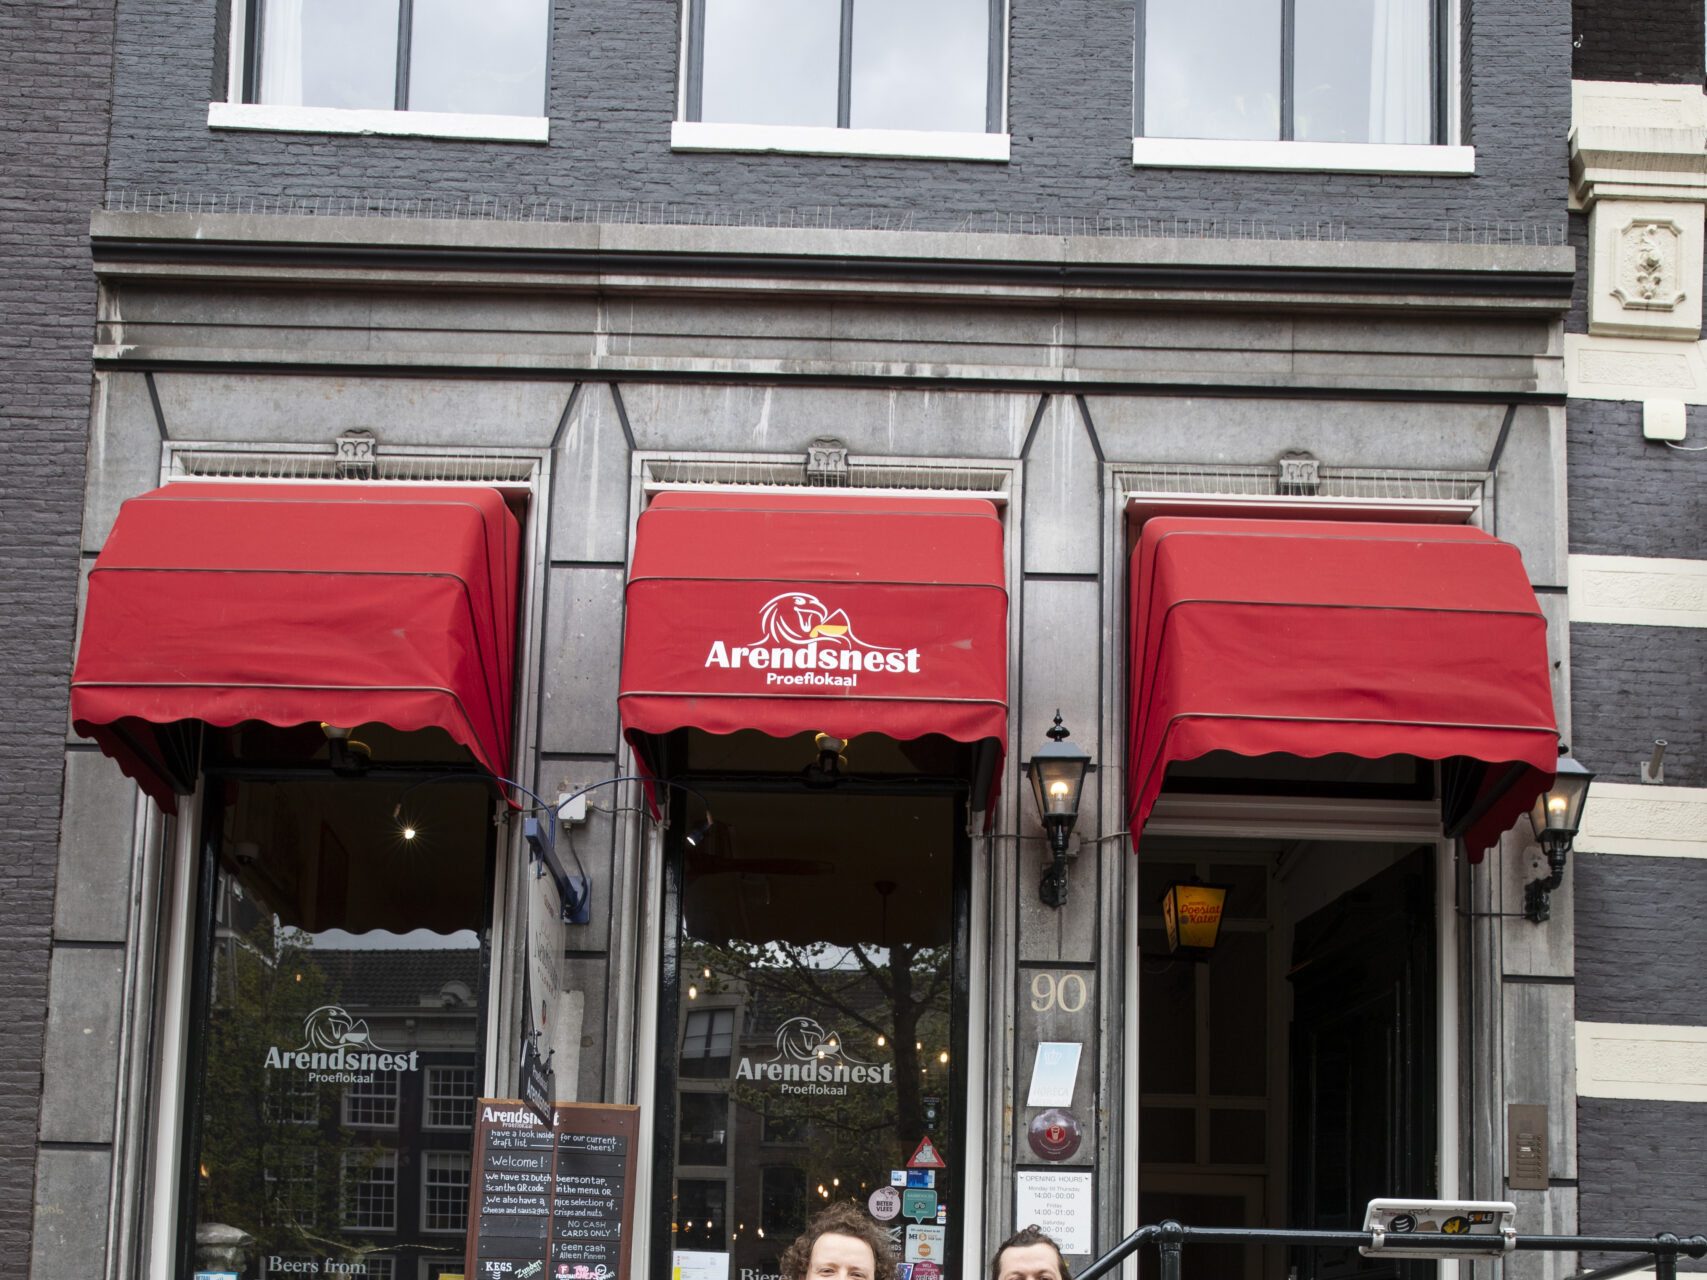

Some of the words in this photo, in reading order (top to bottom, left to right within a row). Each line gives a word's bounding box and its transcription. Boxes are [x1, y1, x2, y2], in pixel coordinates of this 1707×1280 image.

[704, 641, 920, 673] Arendsnest
[766, 672, 857, 687] Proeflokaal
[1031, 973, 1087, 1012] 90
[264, 1046, 419, 1072] Arendsnest
[735, 1057, 892, 1084] Arendsnest
[308, 1072, 374, 1084] Proeflokaal
[781, 1084, 847, 1096] Proeflokaal
[481, 1106, 560, 1127] Arendsnt
[491, 1129, 511, 1137] have
[519, 1130, 535, 1138] look
[492, 1138, 512, 1149] draft
[514, 1139, 528, 1148] list
[500, 1172, 520, 1181] have
[530, 1173, 552, 1182] Dutch
[528, 1183, 545, 1192] code
[577, 1187, 600, 1195] menu
[502, 1195, 518, 1204] also
[518, 1195, 537, 1204] have
[567, 1220, 581, 1228] NO
[582, 1221, 607, 1229] CASH
[561, 1229, 589, 1237] CARDS
[561, 1243, 583, 1251] Geen
[269, 1256, 319, 1273] Beers
[323, 1257, 367, 1274] from
[485, 1261, 513, 1272] KEGS
